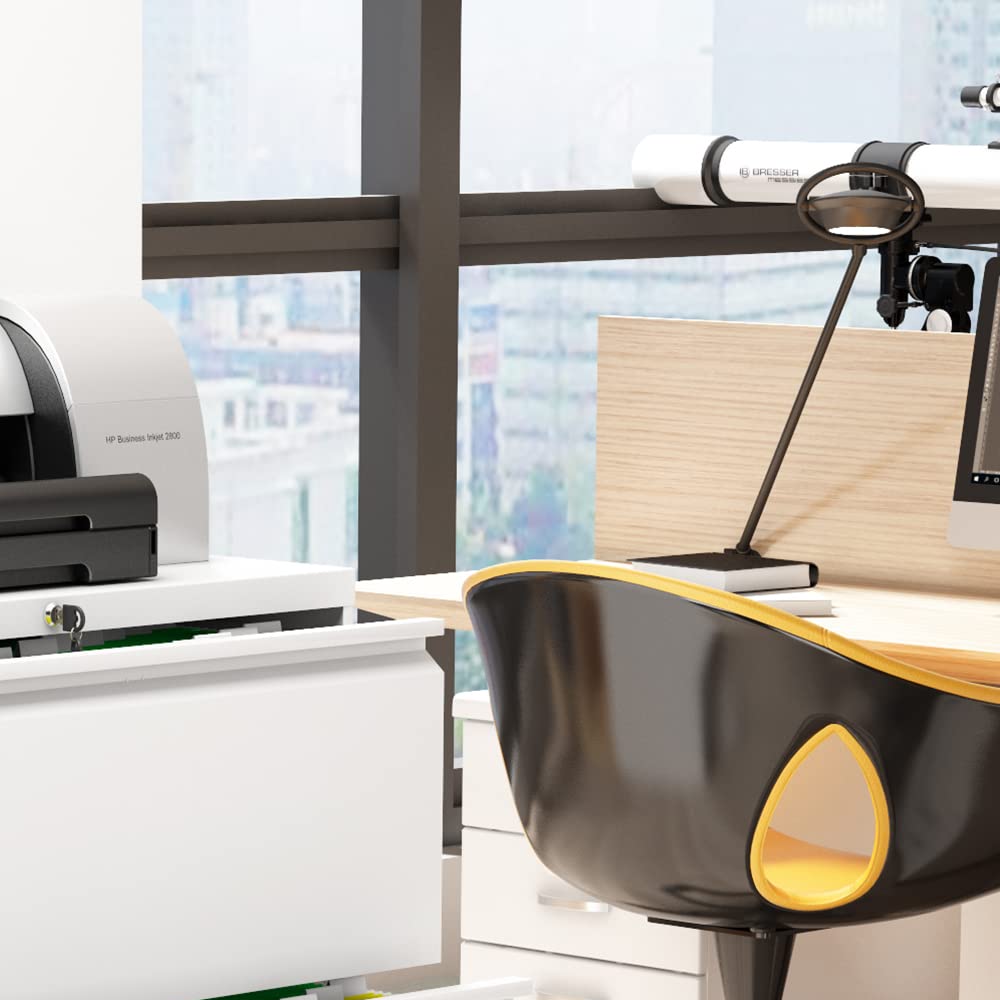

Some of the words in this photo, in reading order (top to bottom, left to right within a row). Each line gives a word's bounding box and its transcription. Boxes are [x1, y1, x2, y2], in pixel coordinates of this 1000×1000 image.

[752, 167, 799, 177] BRESSER
[105, 435, 116, 444] HP
[117, 434, 146, 444] Business
[146, 432, 164, 443] Inkjet
[165, 431, 181, 441] 2800
